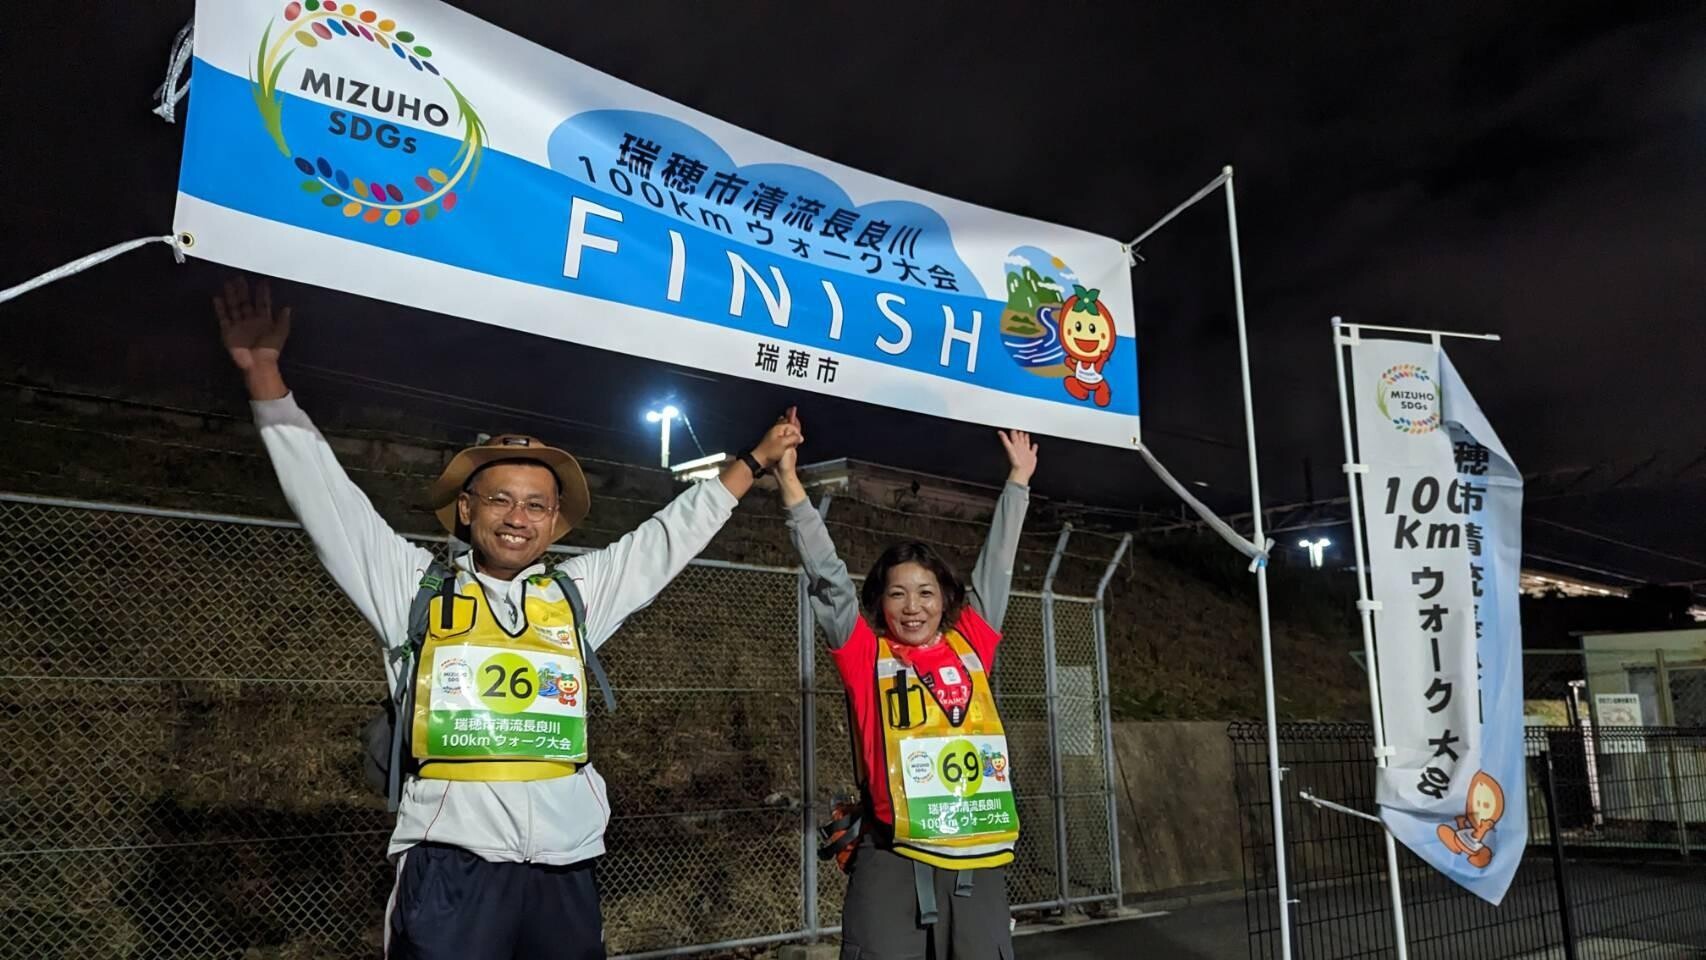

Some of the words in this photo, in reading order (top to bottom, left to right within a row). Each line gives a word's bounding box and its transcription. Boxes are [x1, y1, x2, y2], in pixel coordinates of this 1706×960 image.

[300, 67, 449, 127] MIZUHO
[328, 110, 417, 155] SDGs
[616, 132, 923, 260] 瑞穂市清流長良川
[562, 195, 983, 374] FINISH
[754, 341, 840, 384] 瑞穂市
[1391, 389, 1435, 401] MIZUHO
[1400, 401, 1428, 411] SDGs
[482, 664, 533, 699] 26
[441, 733, 490, 747] 100km
[454, 718, 561, 735] 瑞穂市清流長良川
[942, 751, 979, 783] 69
